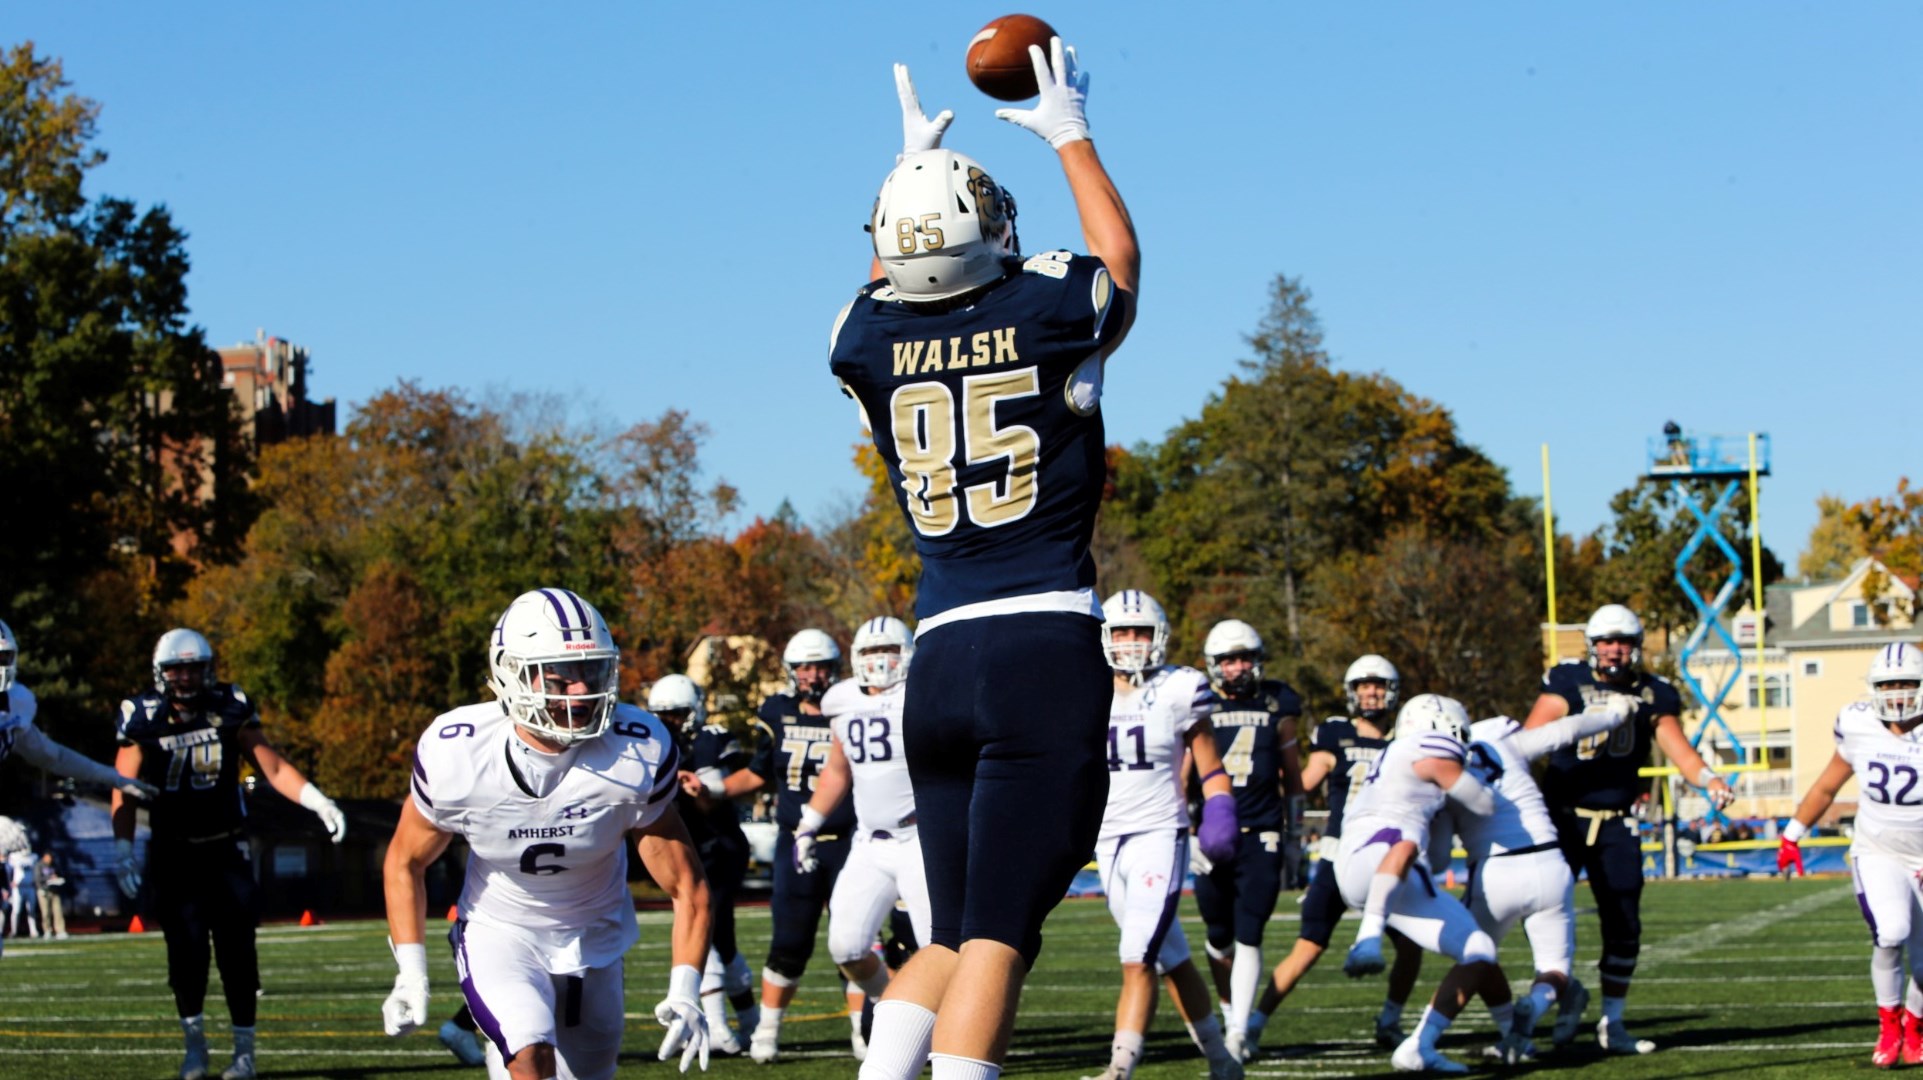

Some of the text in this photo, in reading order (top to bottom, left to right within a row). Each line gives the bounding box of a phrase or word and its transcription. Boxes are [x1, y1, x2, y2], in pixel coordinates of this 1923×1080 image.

[896, 212, 945, 254] 85
[892, 327, 1020, 376] WALSH
[890, 365, 1040, 537] 85
[848, 716, 893, 764] 93
[1210, 710, 1270, 729] TRINITY
[1221, 726, 1257, 787] 4
[1868, 761, 1923, 806] 32
[508, 825, 575, 840] AMHERST
[520, 843, 569, 876] 6
